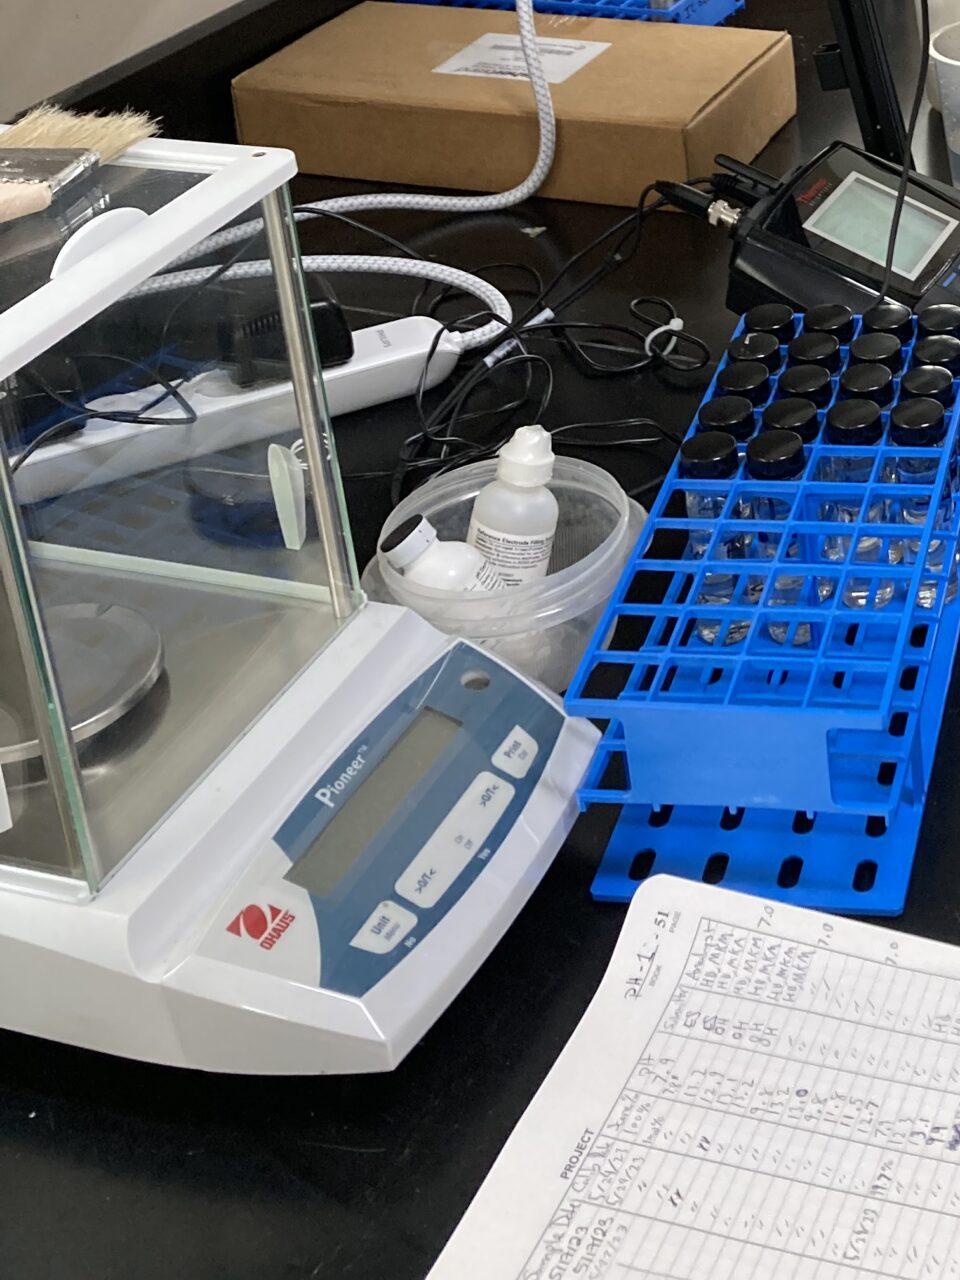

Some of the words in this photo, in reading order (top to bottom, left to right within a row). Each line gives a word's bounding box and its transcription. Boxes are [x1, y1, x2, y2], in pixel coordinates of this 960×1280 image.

[503, 740, 522, 759] Print
[259, 908, 296, 951] OHAUS
[371, 914, 392, 936] Unit
[654, 911, 669, 929] 51
[403, 935, 418, 949] No
[649, 965, 662, 987] BOOK
[559, 1127, 595, 1182] PROJECT
